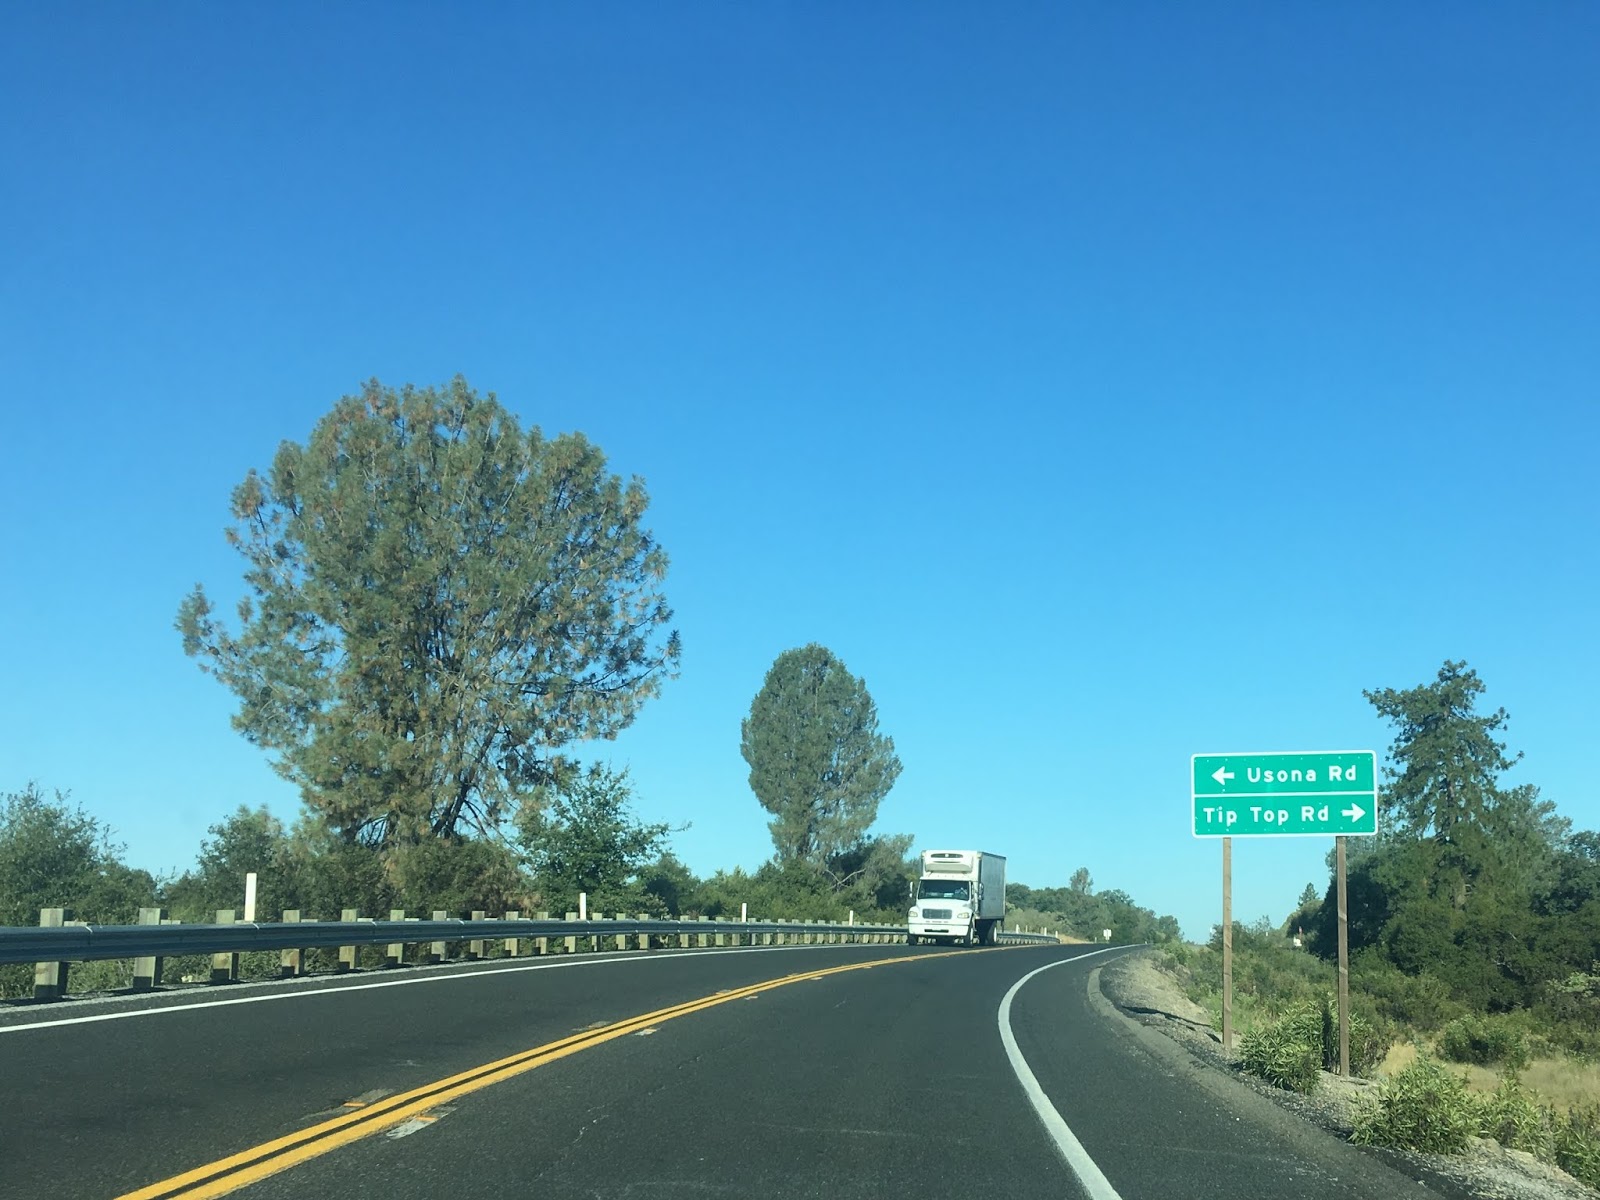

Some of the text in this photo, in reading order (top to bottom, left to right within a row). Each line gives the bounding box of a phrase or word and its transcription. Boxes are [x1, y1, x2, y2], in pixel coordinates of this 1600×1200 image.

[1247, 765, 1357, 783] Usona Rd
[1203, 805, 1329, 826] Tip Top Rd
